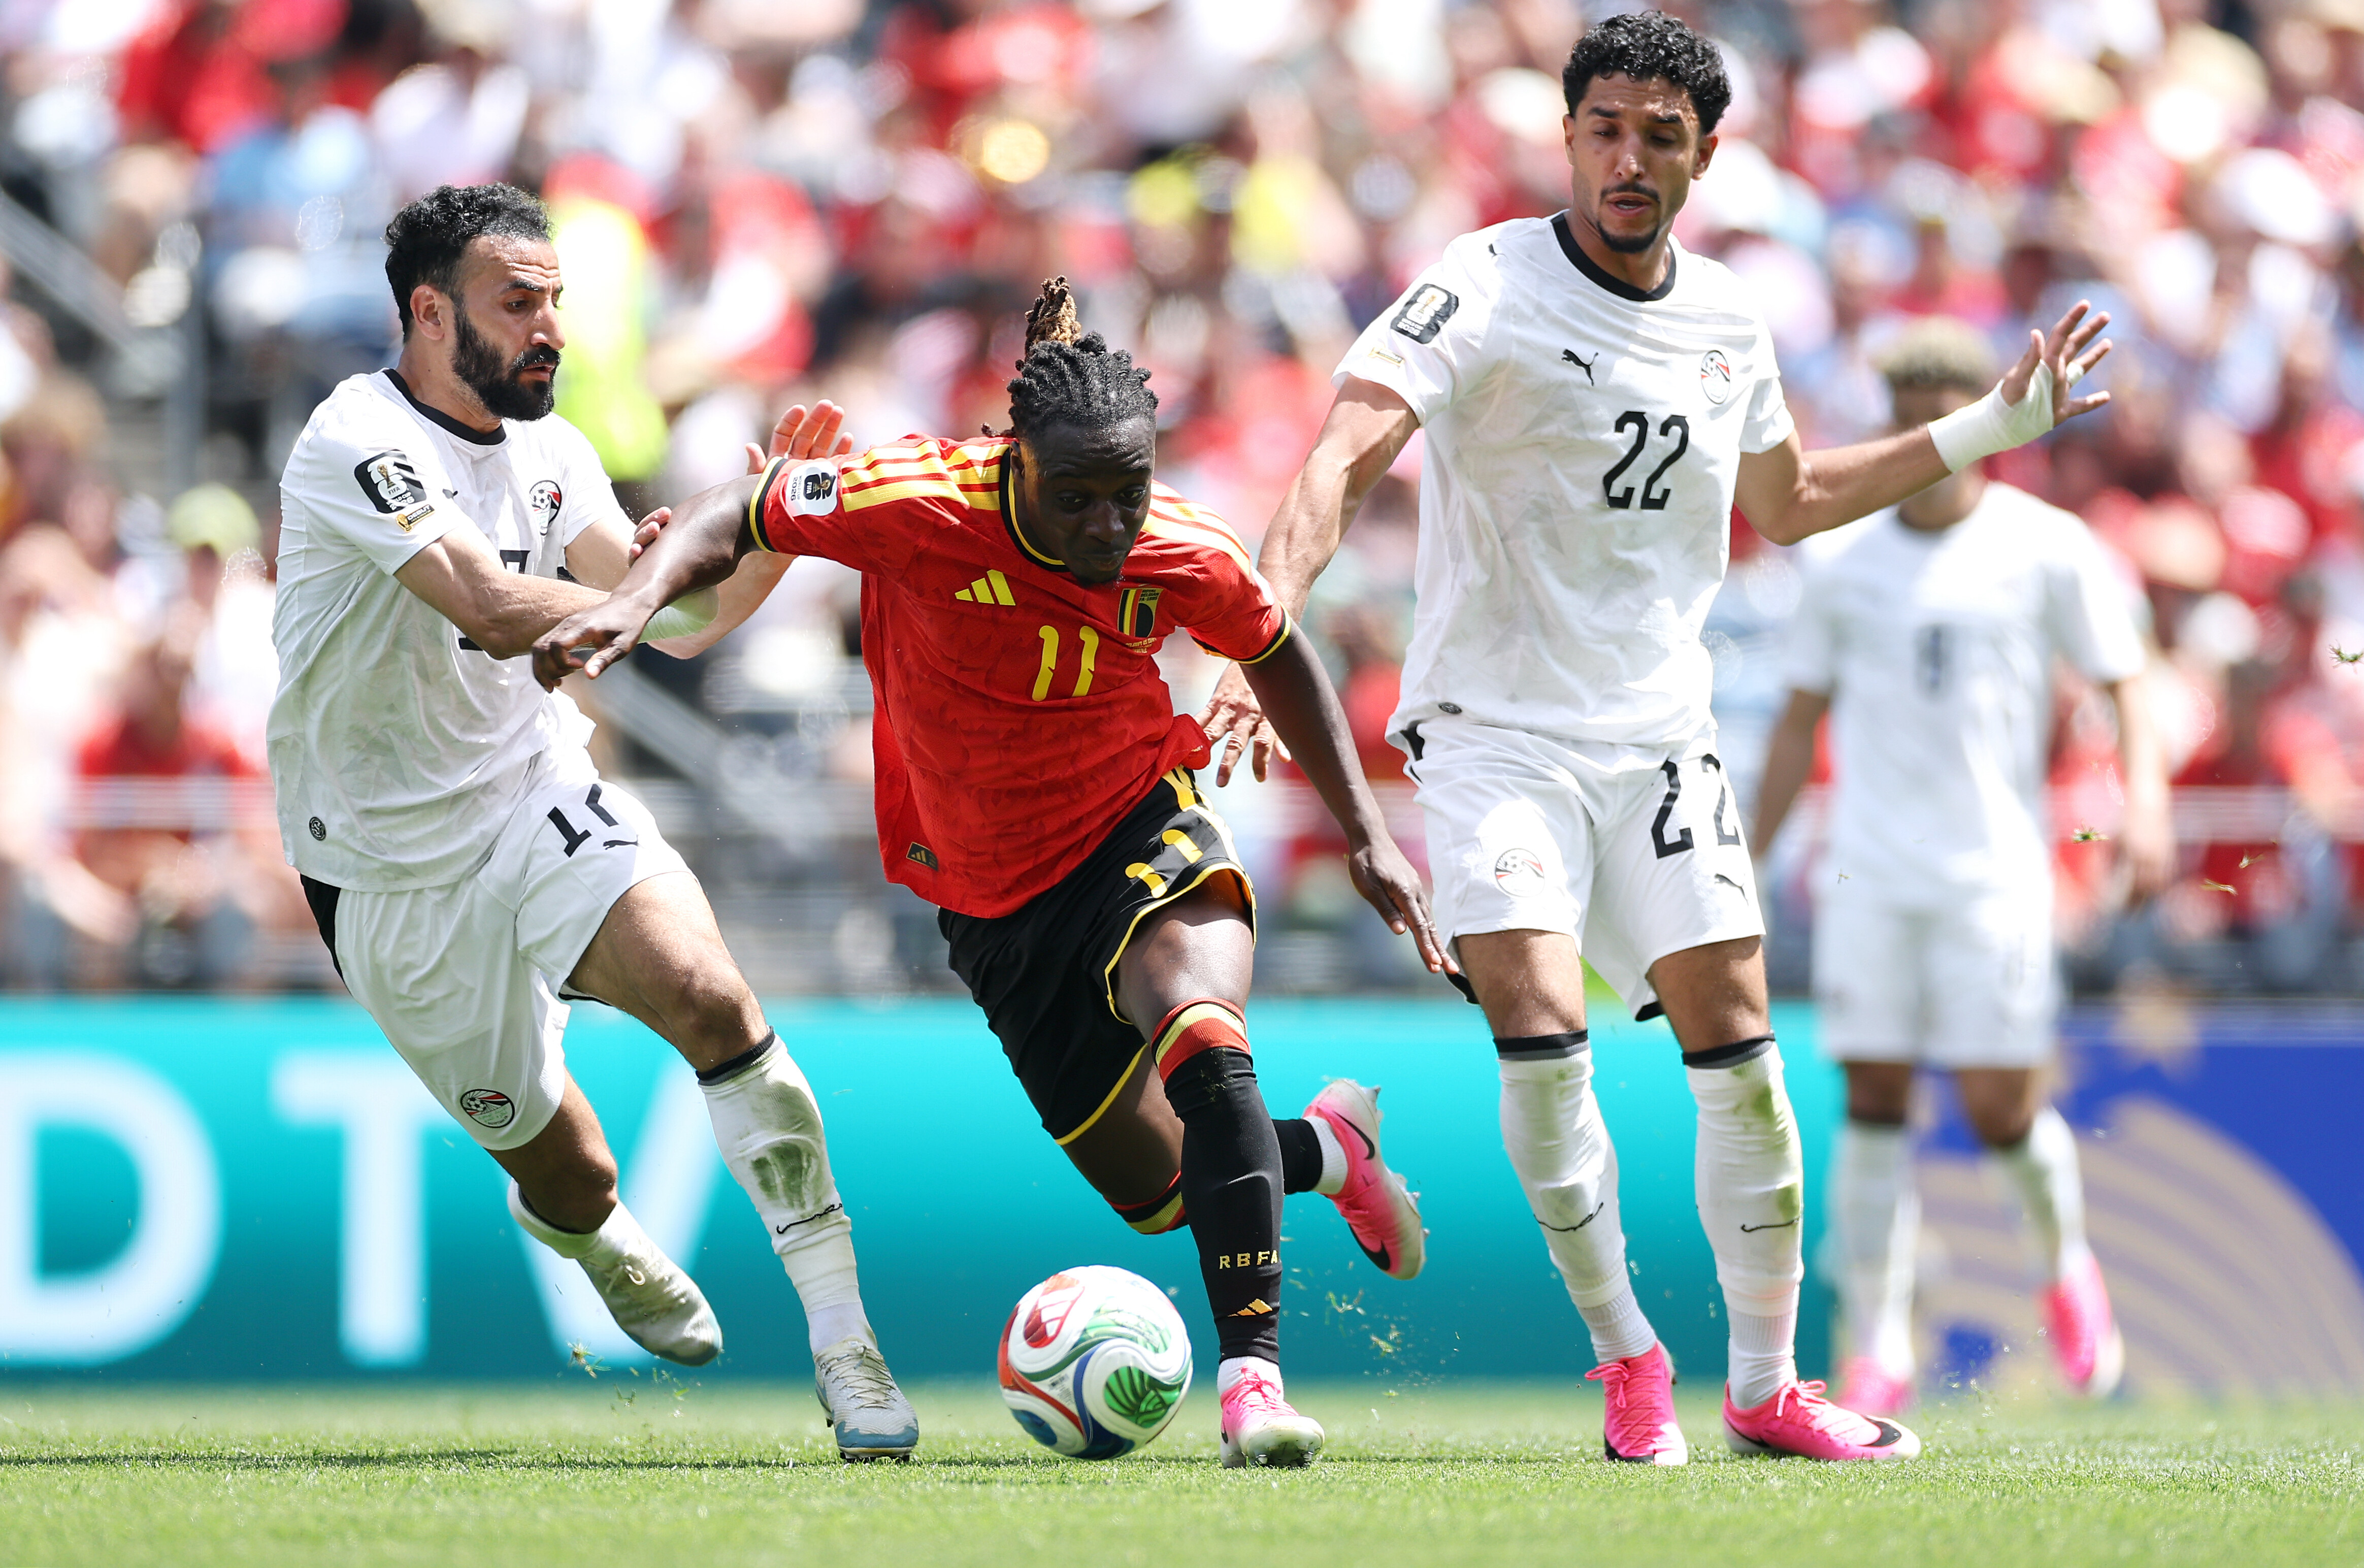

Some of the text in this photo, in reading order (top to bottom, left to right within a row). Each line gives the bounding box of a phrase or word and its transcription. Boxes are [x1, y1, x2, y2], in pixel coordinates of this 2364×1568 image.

[1397, 321, 1421, 336] 2026
[1603, 411, 1689, 510] 22
[407, 505, 430, 520] DEBUT
[1032, 625, 1099, 702] 11
[1651, 754, 1741, 859] 22
[1125, 829, 1203, 899] 11
